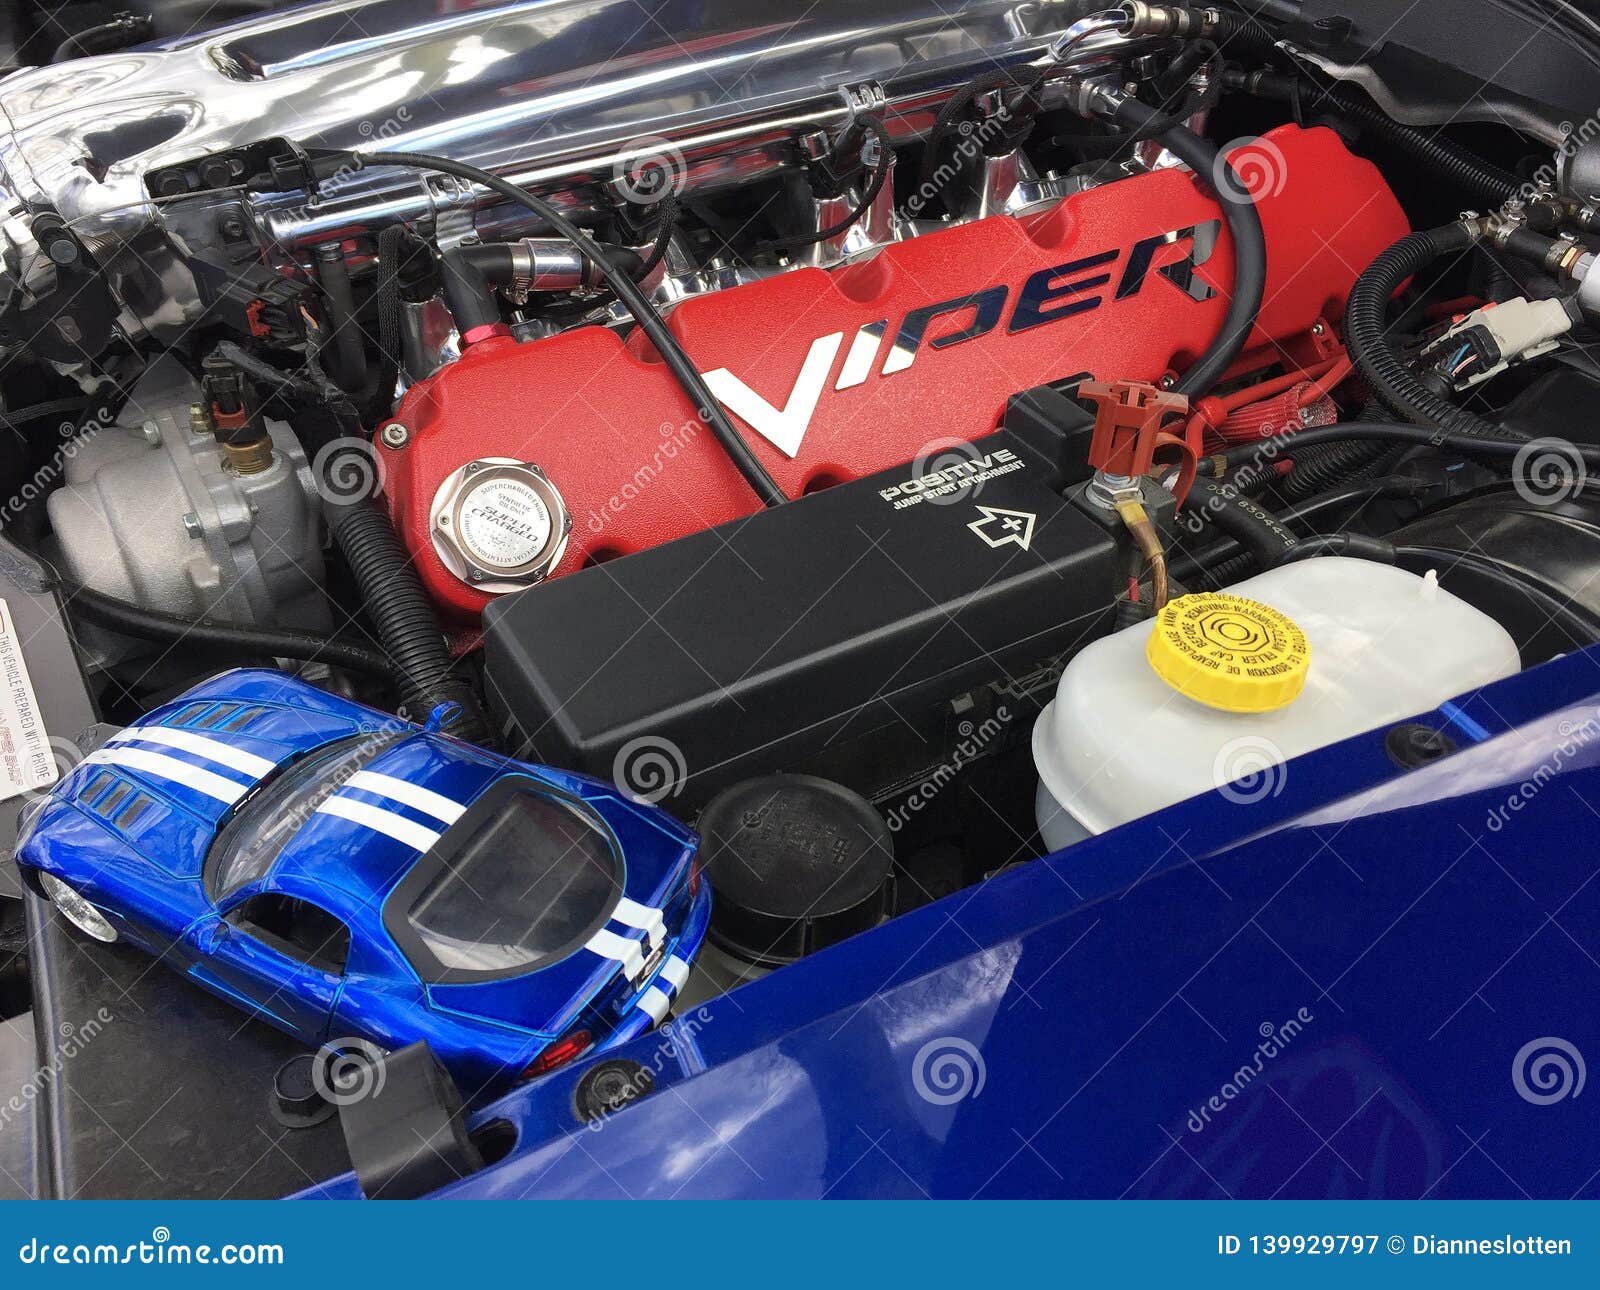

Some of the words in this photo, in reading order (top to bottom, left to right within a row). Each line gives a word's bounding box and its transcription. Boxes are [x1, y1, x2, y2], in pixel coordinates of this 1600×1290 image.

[701, 220, 1221, 458] VIPER
[879, 449, 1017, 502] POSITIVE
[893, 494, 923, 510] JUMP
[923, 483, 957, 499] START
[958, 459, 1025, 489] ATTACHMENT
[471, 507, 538, 542] CHARGED
[484, 505, 532, 532] SUPER
[0, 635, 12, 654] THIS
[1181, 622, 1208, 648] BEFORE
[1210, 651, 1233, 661] CAP
[1241, 651, 1278, 664] FILLER
[3, 654, 22, 687] VEHICLE
[12, 687, 36, 729] PREPARED
[24, 729, 41, 751] WITH
[32, 752, 50, 780] PRIDE
